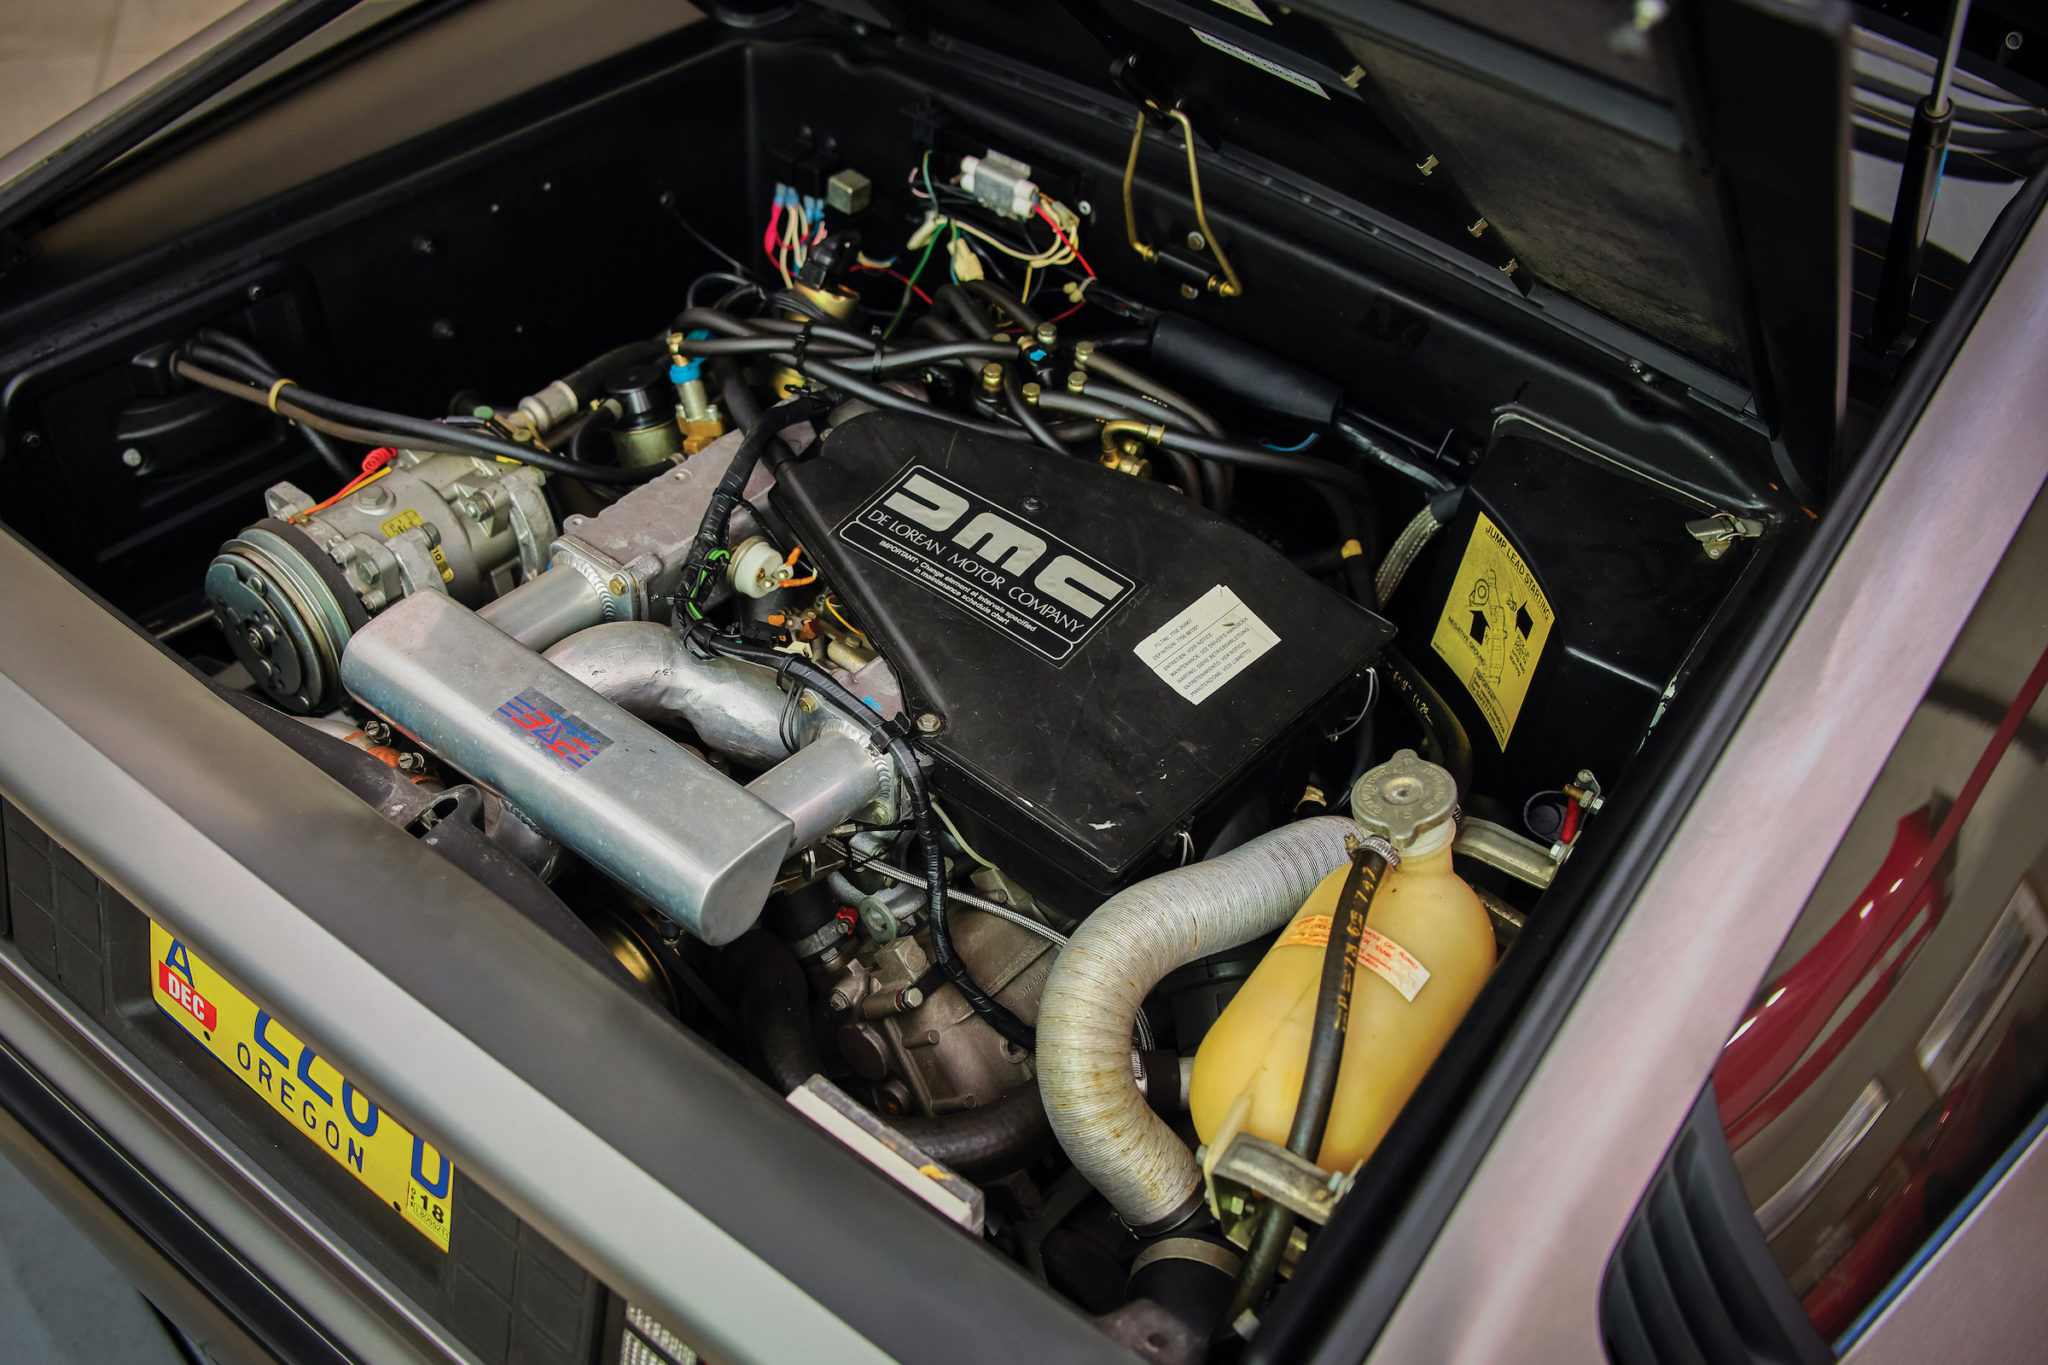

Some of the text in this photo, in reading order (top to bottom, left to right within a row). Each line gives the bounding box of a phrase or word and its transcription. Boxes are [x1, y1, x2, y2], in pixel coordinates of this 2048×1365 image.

[868, 510, 1085, 633] DE LOREAN MOTOR COMPANY
[920, 561, 944, 578] Change
[944, 575, 971, 593] element
[978, 594, 1005, 613] intervals
[1005, 610, 1038, 632] specified
[921, 571, 962, 597] maintenance
[961, 593, 991, 614] schedule
[991, 610, 1009, 626] chart
[1485, 525, 1550, 621] JUMP LEAD STARTING
[168, 972, 205, 1021] DEC
[237, 1042, 364, 1174] OREGON
[421, 1195, 444, 1224] 18
